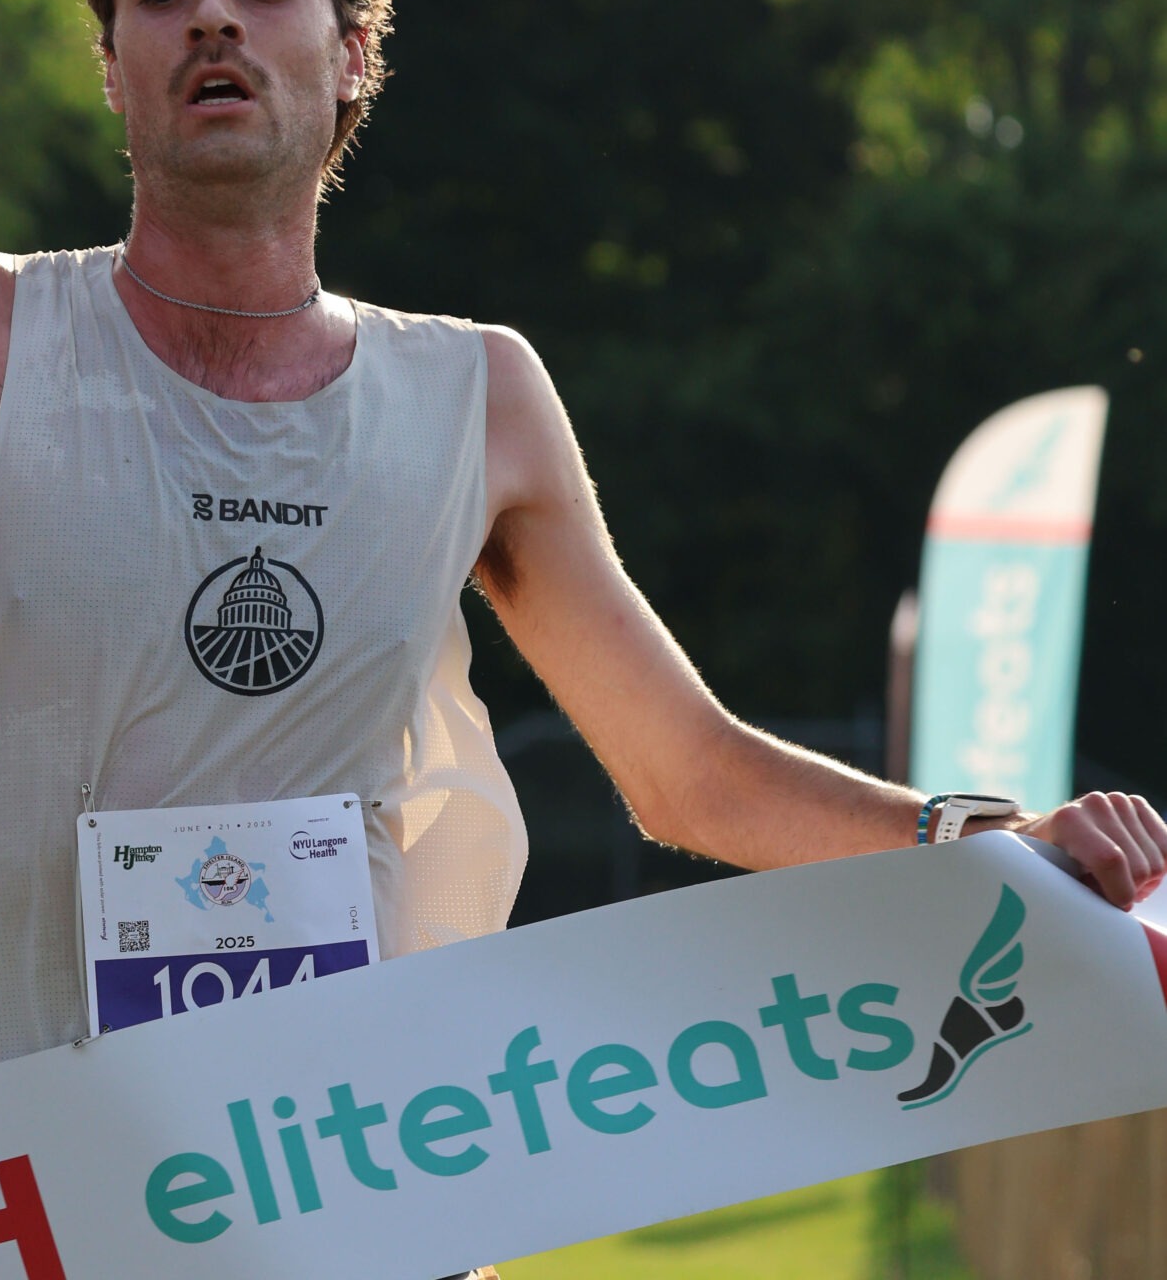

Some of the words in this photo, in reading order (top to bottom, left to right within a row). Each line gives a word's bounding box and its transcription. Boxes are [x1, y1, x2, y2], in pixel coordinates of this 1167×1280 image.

[218, 497, 329, 527] BANDIT
[960, 562, 1043, 806] feats
[173, 825, 201, 833] JUNE
[218, 823, 230, 831] 21
[246, 820, 272, 829] 2025
[293, 839, 312, 850] NYU
[312, 837, 348, 848] Langone
[113, 844, 163, 863] Hampton
[309, 848, 338, 859] Health
[348, 905, 359, 931] 1044
[215, 935, 255, 950] 2025
[145, 973, 915, 1244] elitefeats
